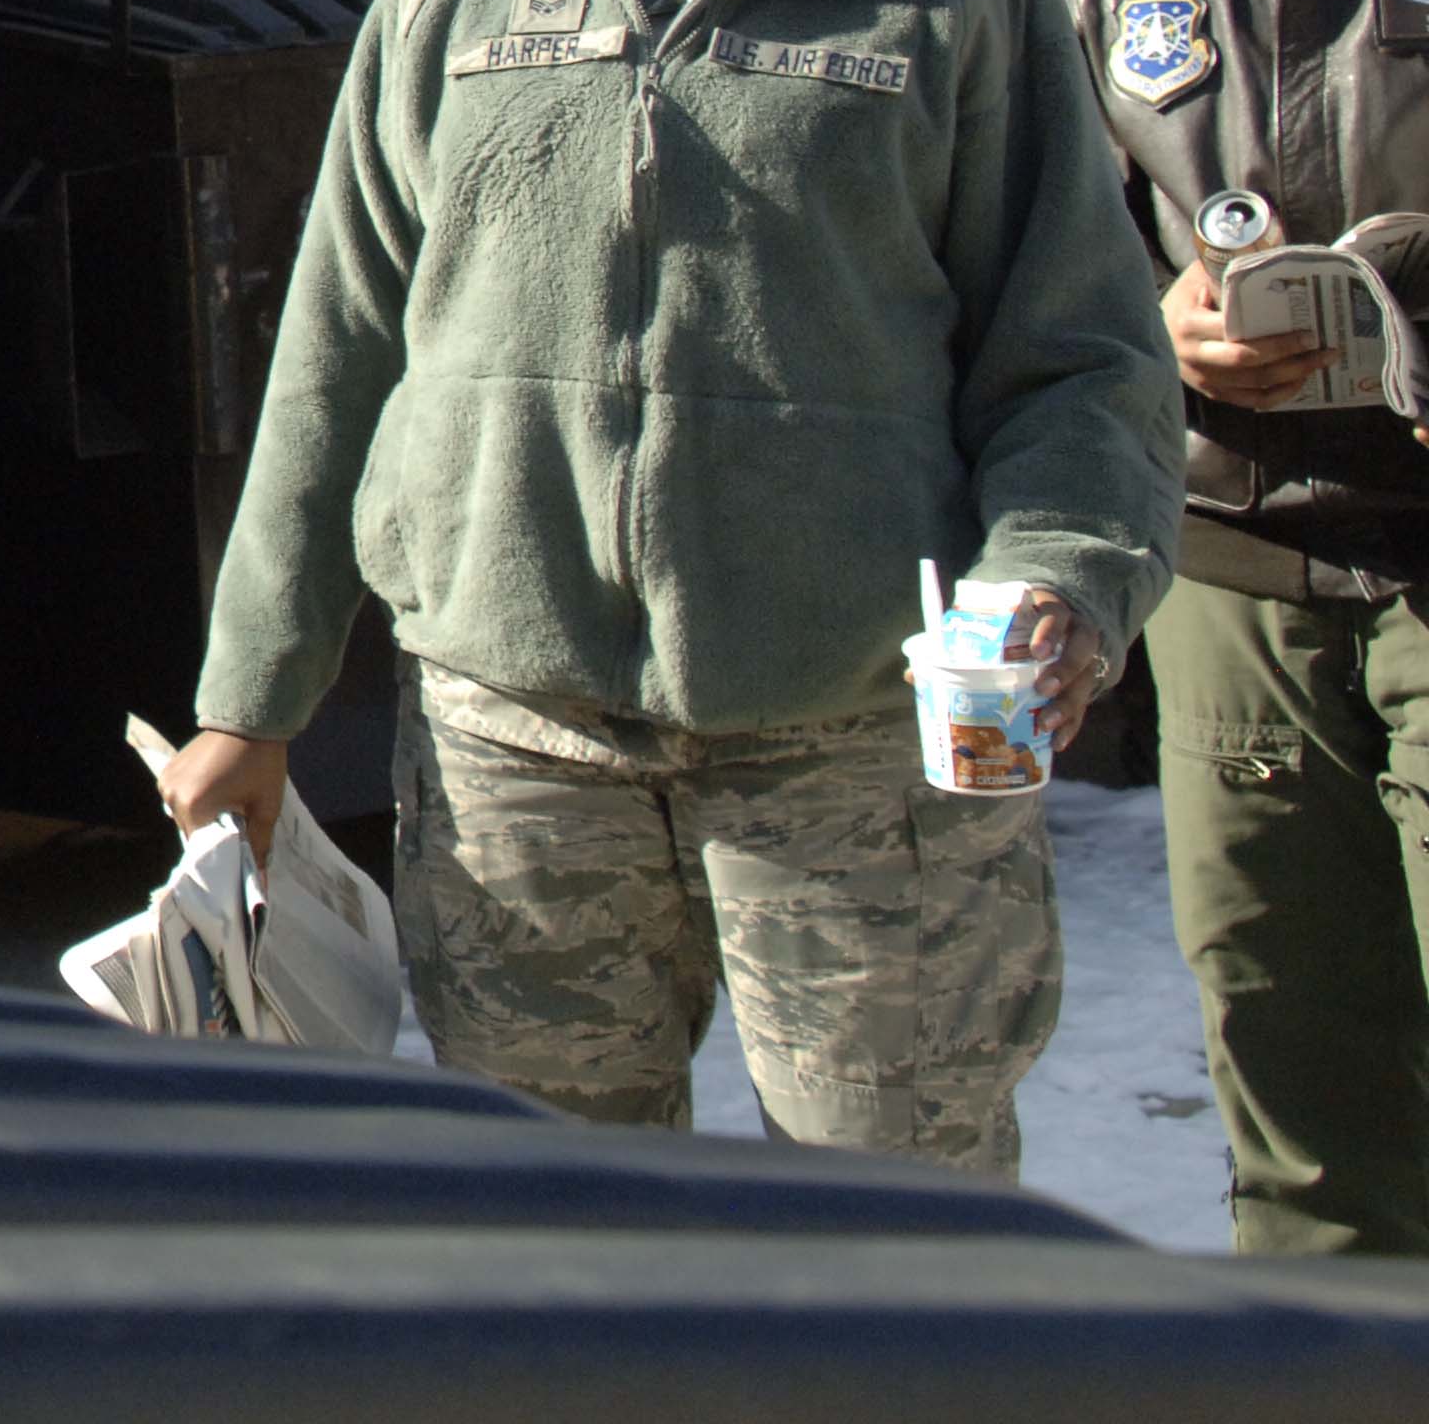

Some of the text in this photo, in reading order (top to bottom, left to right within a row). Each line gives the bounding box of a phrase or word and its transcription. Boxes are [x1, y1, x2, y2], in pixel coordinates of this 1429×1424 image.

[487, 36, 581, 68] HARPER
[716, 32, 907, 87] U.S. AIR FORCE
